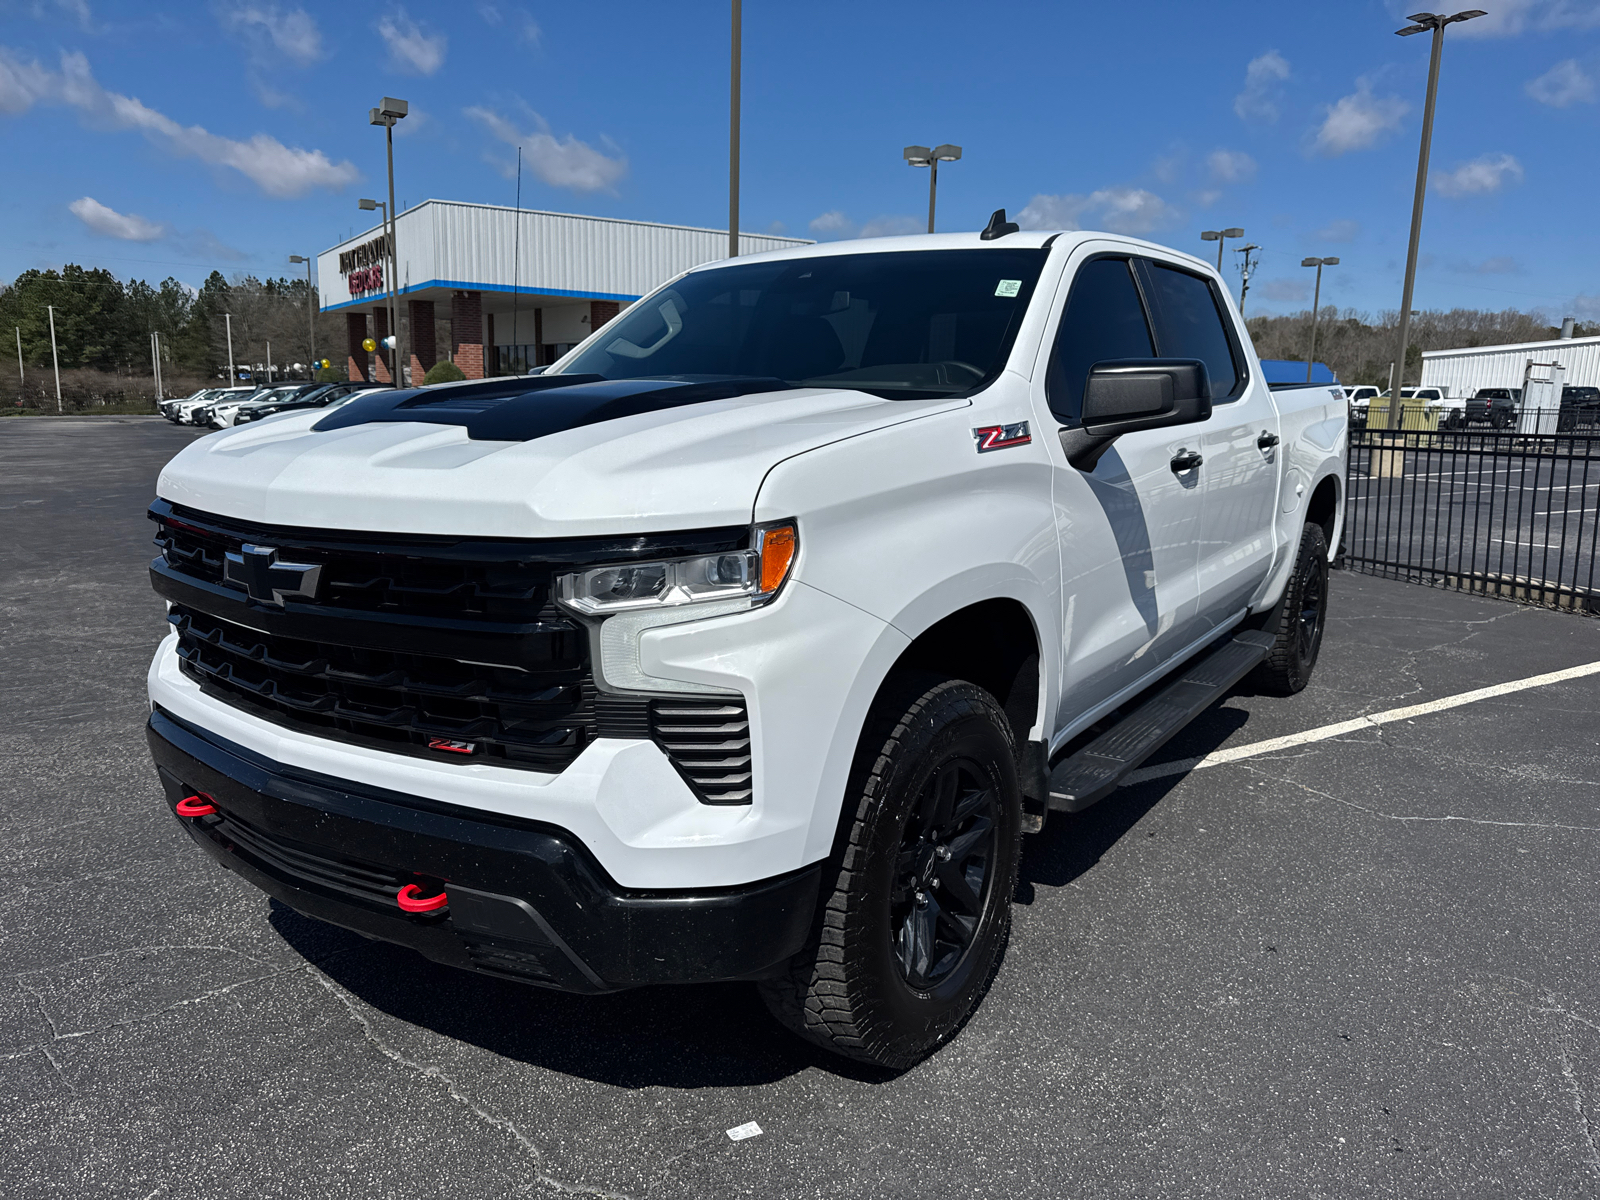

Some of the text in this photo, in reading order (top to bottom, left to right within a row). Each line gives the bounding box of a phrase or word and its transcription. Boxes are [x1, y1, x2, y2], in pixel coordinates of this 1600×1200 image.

[348, 264, 381, 294] USED CARS
[971, 420, 1032, 454] Z71
[428, 737, 476, 755] Z71
